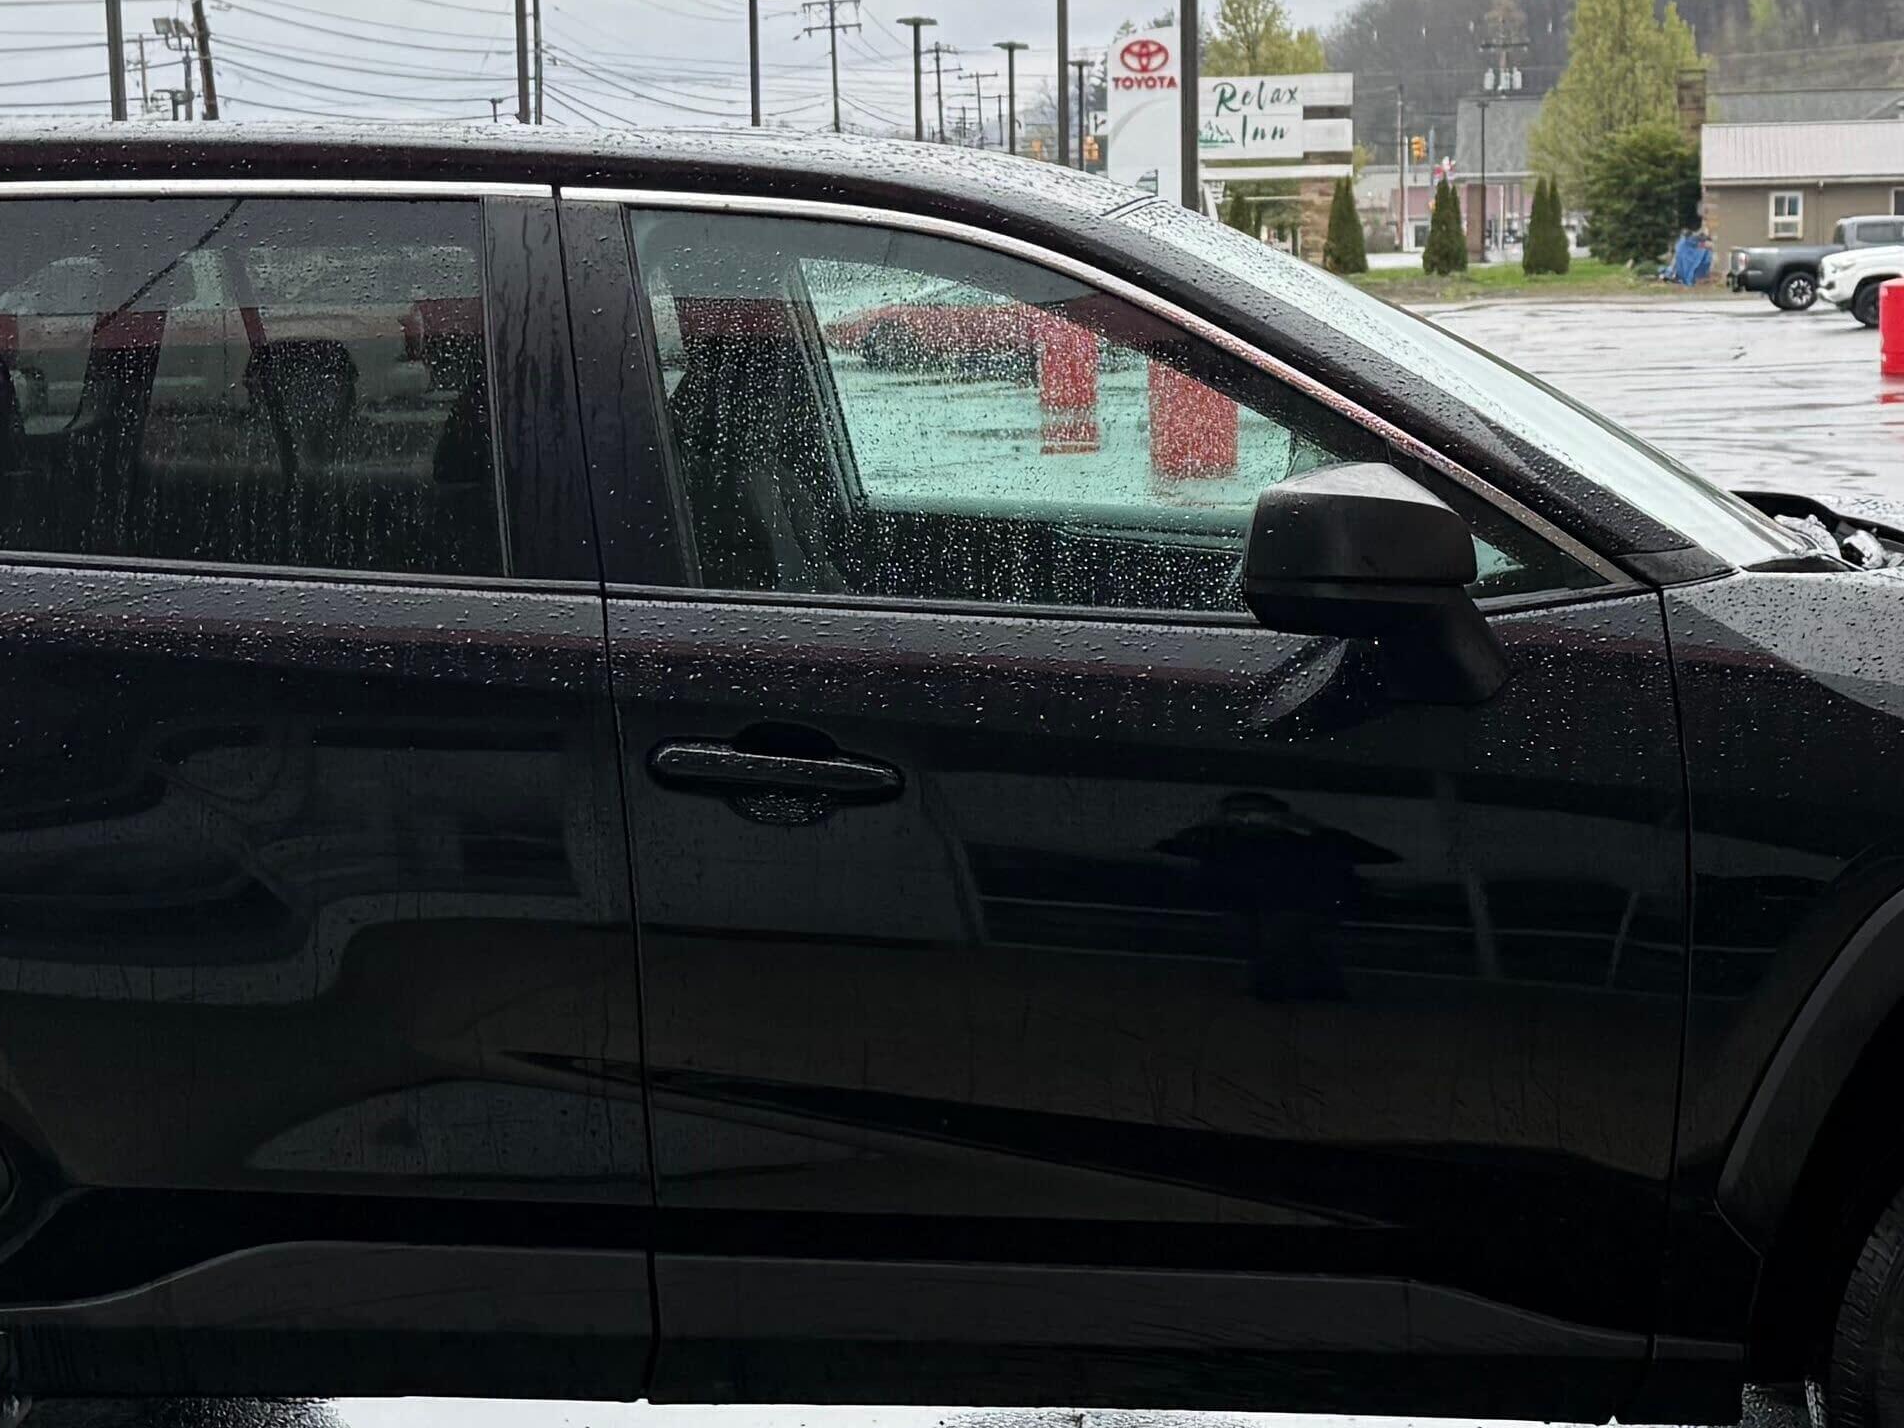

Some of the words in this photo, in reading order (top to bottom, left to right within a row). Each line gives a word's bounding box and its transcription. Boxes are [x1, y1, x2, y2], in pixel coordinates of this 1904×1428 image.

[1112, 75, 1178, 91] TOYOTA
[1212, 80, 1300, 117] Relax
[1241, 114, 1289, 148] Inn
